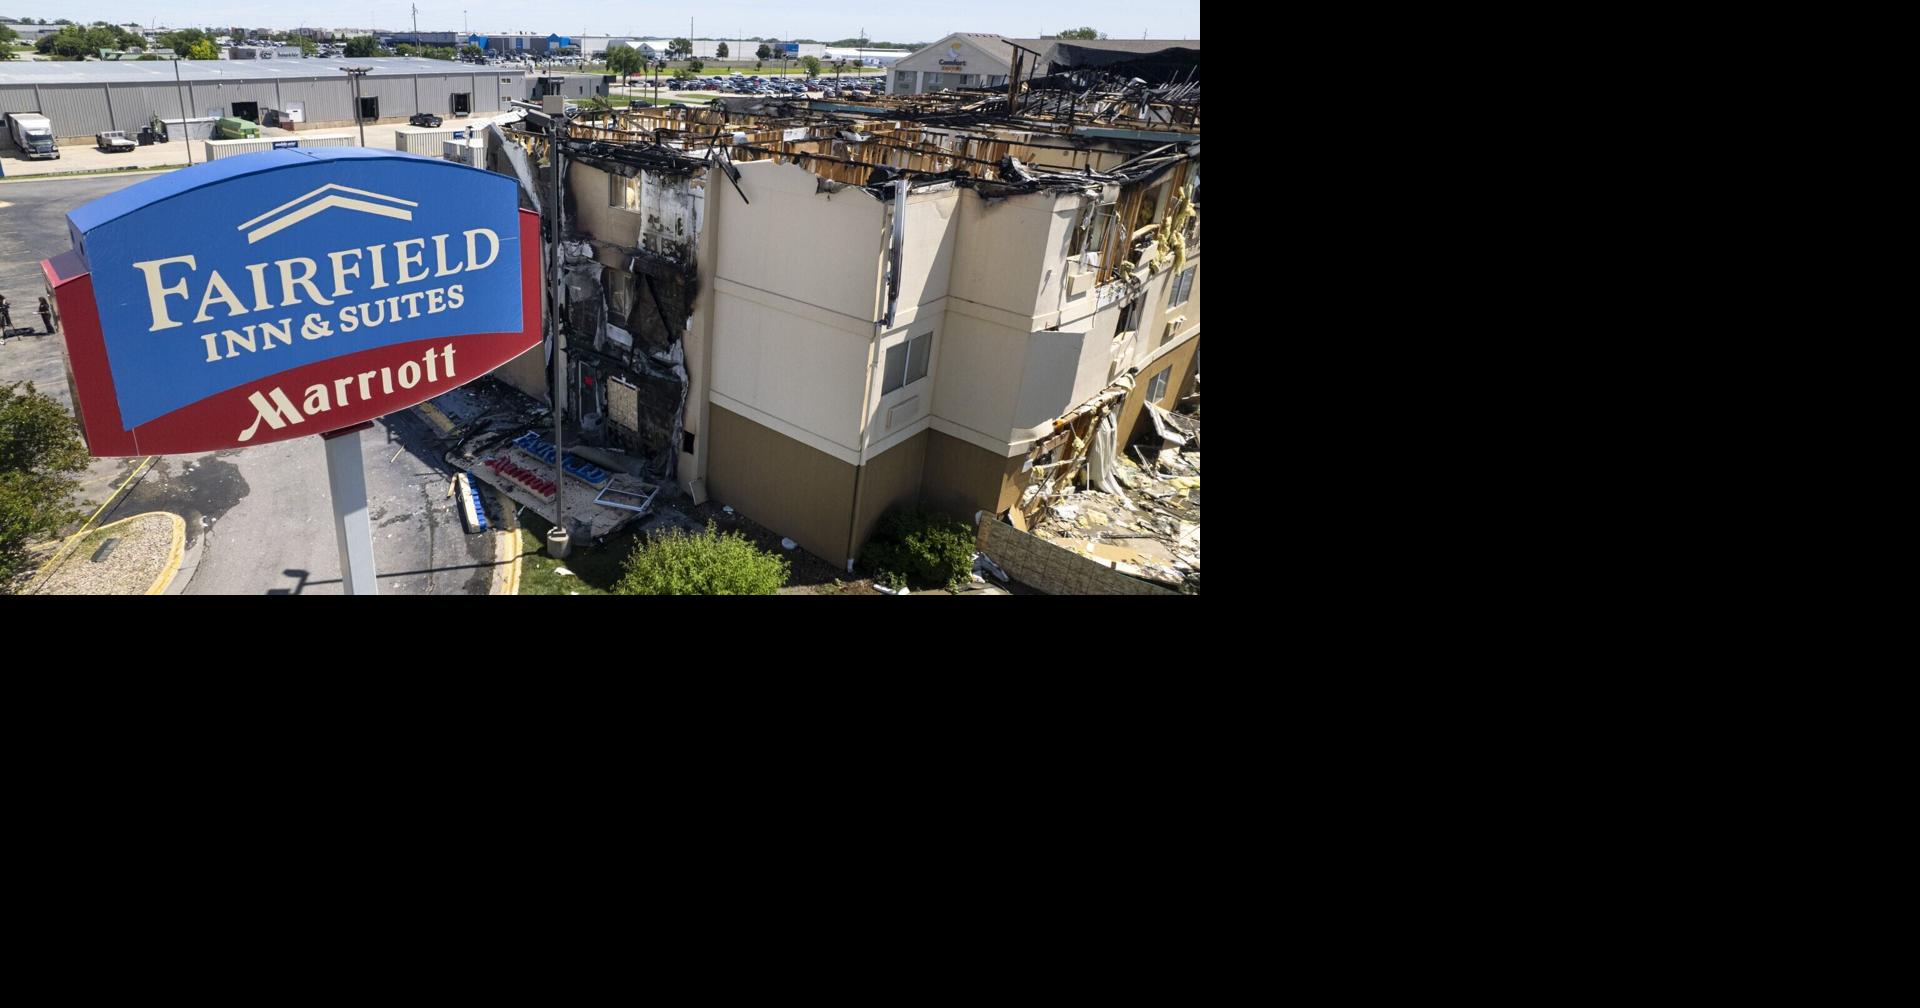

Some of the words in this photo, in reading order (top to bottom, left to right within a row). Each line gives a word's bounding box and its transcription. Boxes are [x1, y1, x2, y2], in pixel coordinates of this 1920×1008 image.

[132, 228, 500, 332] FAIRFIELD
[200, 318, 292, 363] INN
[300, 313, 334, 340] &
[339, 284, 465, 332] SUITES
[237, 343, 457, 442] Marriott
